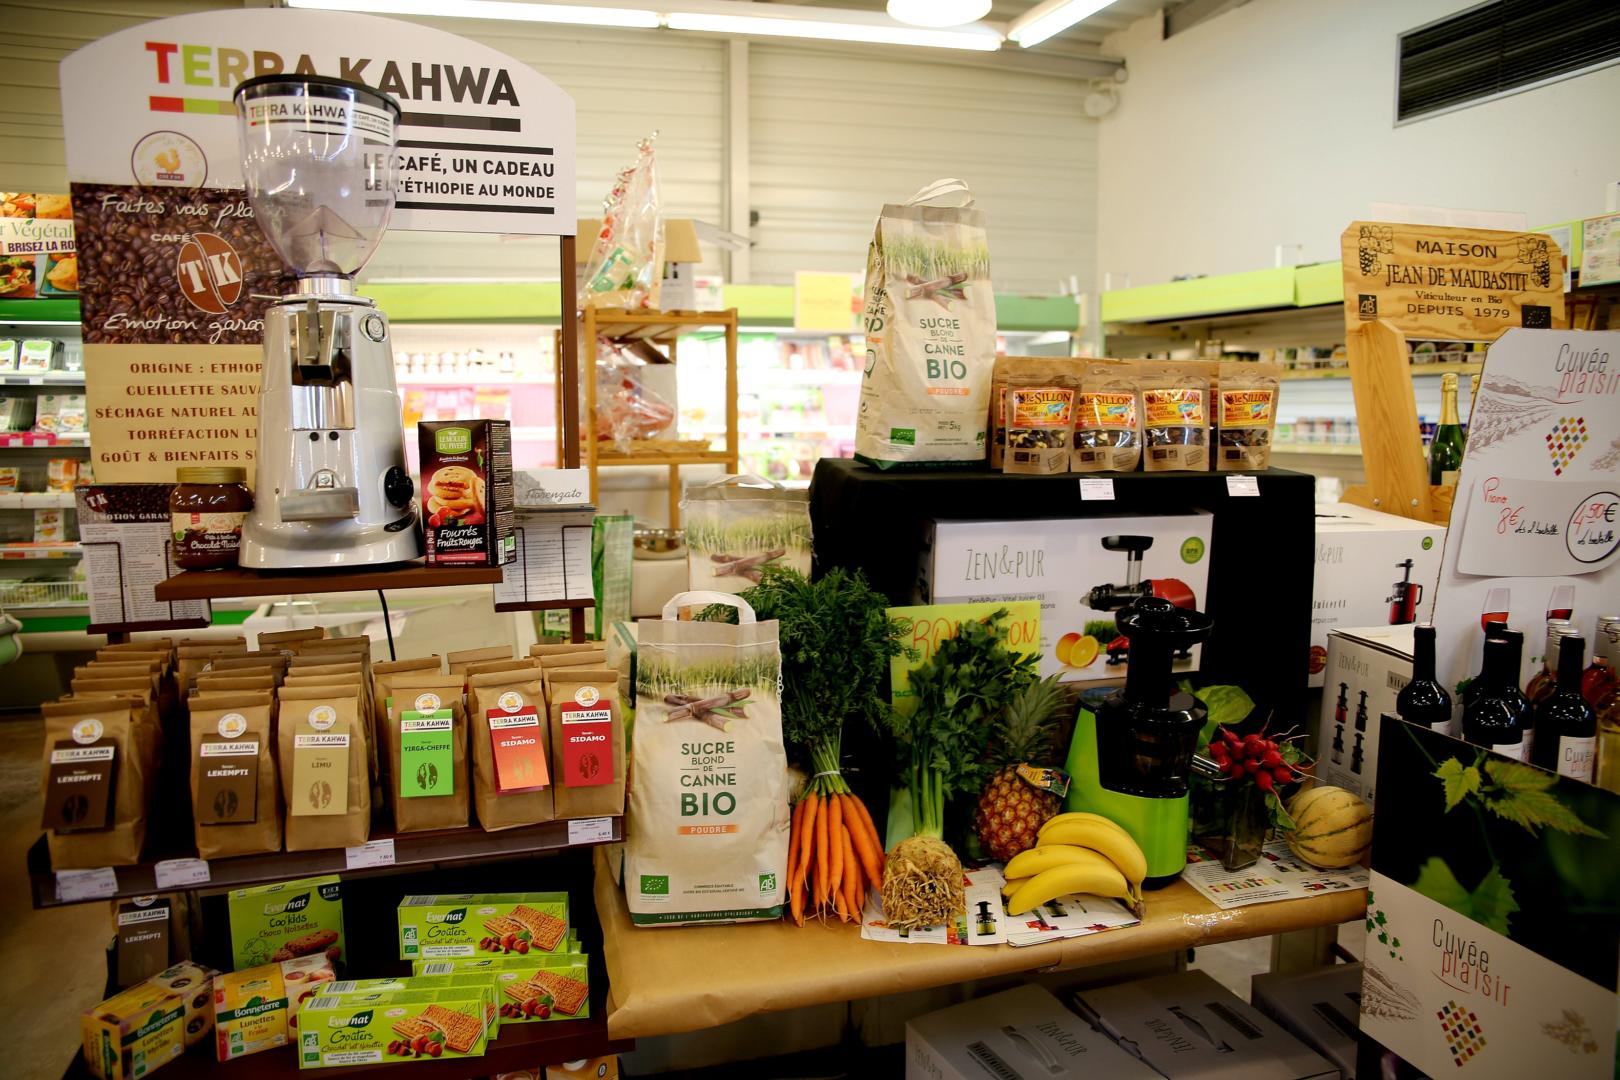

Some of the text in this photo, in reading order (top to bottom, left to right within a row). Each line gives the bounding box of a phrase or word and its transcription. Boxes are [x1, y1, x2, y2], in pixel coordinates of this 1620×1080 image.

[339, 57, 520, 107] KAHWA
[249, 104, 347, 119] TERRA KAHWA
[452, 159, 478, 174] UN
[483, 160, 554, 177] CADEAU
[478, 184, 499, 196] AU
[503, 185, 555, 199] MONDE
[100, 193, 165, 214] Faites
[175, 200, 209, 216] vous
[11, 222, 73, 240] Végétal
[151, 232, 192, 243] CAFÉ
[8, 240, 78, 253] BRISEZ LA RO
[1416, 240, 1498, 259] MAISON
[1385, 264, 1529, 292] JEAN DE MAUBASTIT
[1415, 290, 1468, 303] Viticulteur
[1488, 295, 1503, 304] Bio
[1407, 303, 1510, 319] DEPUIS 1979
[104, 313, 198, 331] Emotion
[919, 318, 960, 330] SUCRE
[930, 330, 954, 338] BLOND
[924, 343, 965, 356] CANNE
[1555, 343, 1609, 374] Cuvée
[130, 363, 193, 374] ORIGINE
[927, 359, 967, 380] BIO
[126, 385, 215, 396] CUEILLETTE
[1035, 392, 1072, 404] SILLON
[1242, 392, 1270, 405] SILLON
[95, 406, 165, 418] SÉCHAGE
[171, 407, 236, 418] NATUREL
[128, 428, 239, 440] TORRÉFACTION
[101, 451, 140, 463] GOÛT
[148, 452, 158, 463] &
[164, 451, 239, 462] BIENFAITS
[139, 512, 171, 521] GARAN
[440, 526, 478, 538] Fourrés
[964, 544, 1044, 581] ZEN&PUR
[426, 719, 450, 727] KAHWA
[500, 738, 536, 747] SIDAMO
[570, 735, 606, 743] SIDAMO
[83, 748, 110, 756] KAHWA
[681, 741, 735, 756] SUCRE
[691, 756, 725, 765] BLOND
[57, 774, 102, 784] LEKEMPTI
[207, 768, 249, 777] LEKEMPTI
[680, 773, 736, 787] CANNE
[680, 791, 736, 817] BIO
[690, 825, 727, 834] POUDRE
[264, 898, 306, 914] Evernat
[426, 912, 464, 921] Evernat
[125, 932, 161, 944] LEKEMPTI
[259, 929, 282, 938] Choco
[427, 925, 467, 938] Goûters
[1432, 918, 1489, 973] Cuvée
[1441, 950, 1511, 1007] plaisir
[234, 1001, 280, 1018] Bonneterre
[137, 1010, 178, 1037] Bonneterre
[239, 1015, 275, 1029] Lunettes
[328, 1015, 369, 1026] Evernat
[330, 1029, 374, 1044] Goûters
